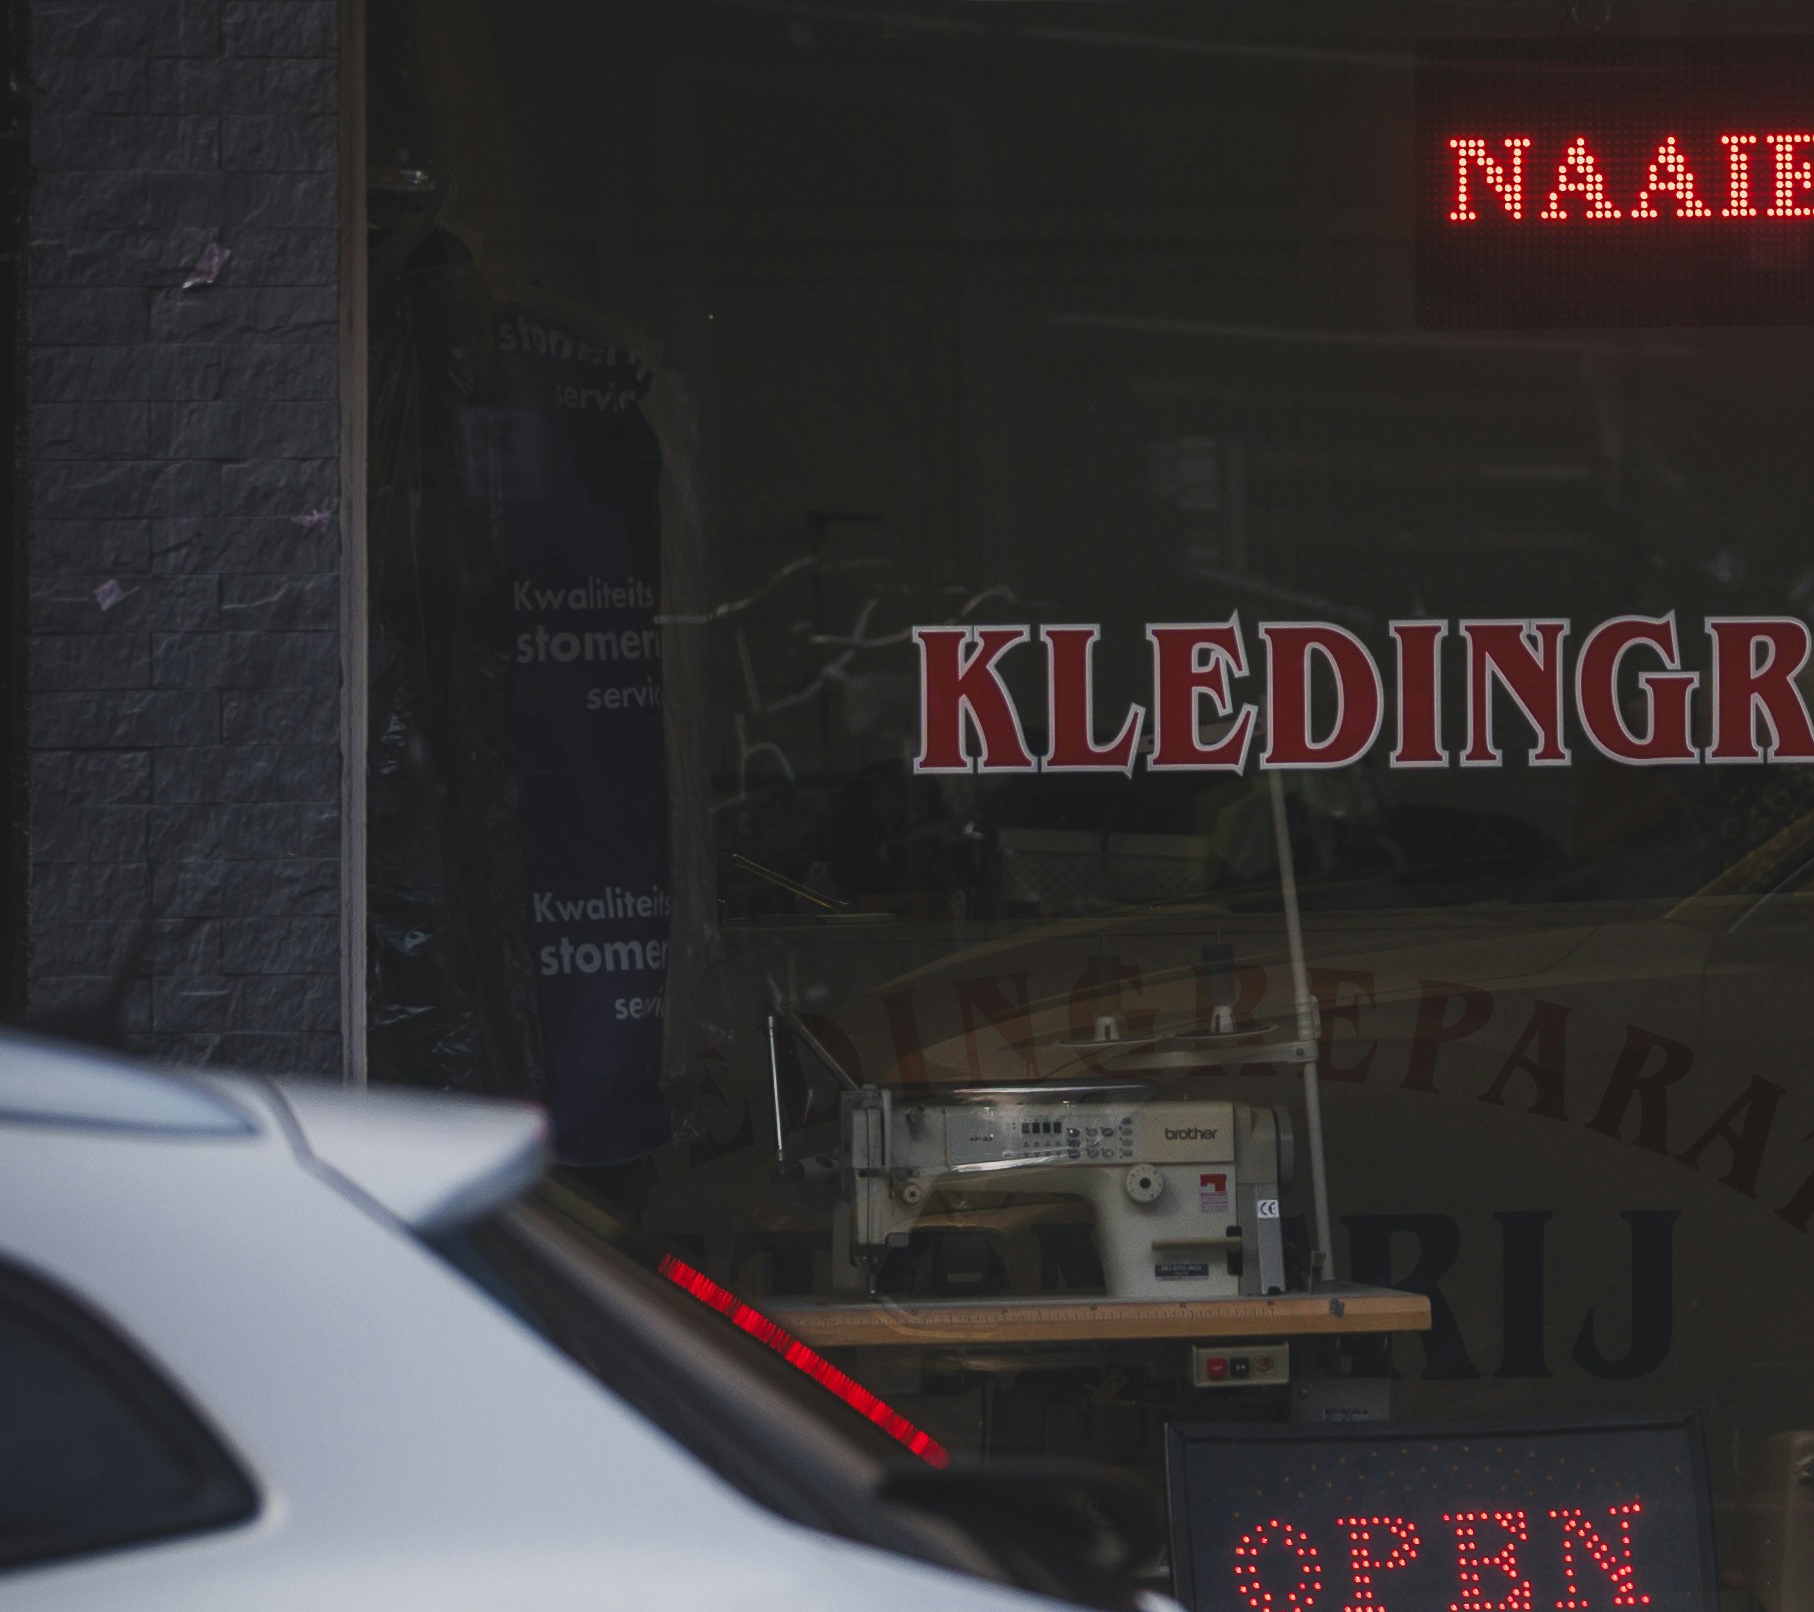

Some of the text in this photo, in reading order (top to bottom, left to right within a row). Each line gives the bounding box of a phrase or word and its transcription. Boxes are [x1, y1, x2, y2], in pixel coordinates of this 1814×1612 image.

[513, 575, 654, 611] Kwaliteits
[533, 884, 673, 923] Kwaliteits
[1164, 1127, 1218, 1141] brother
